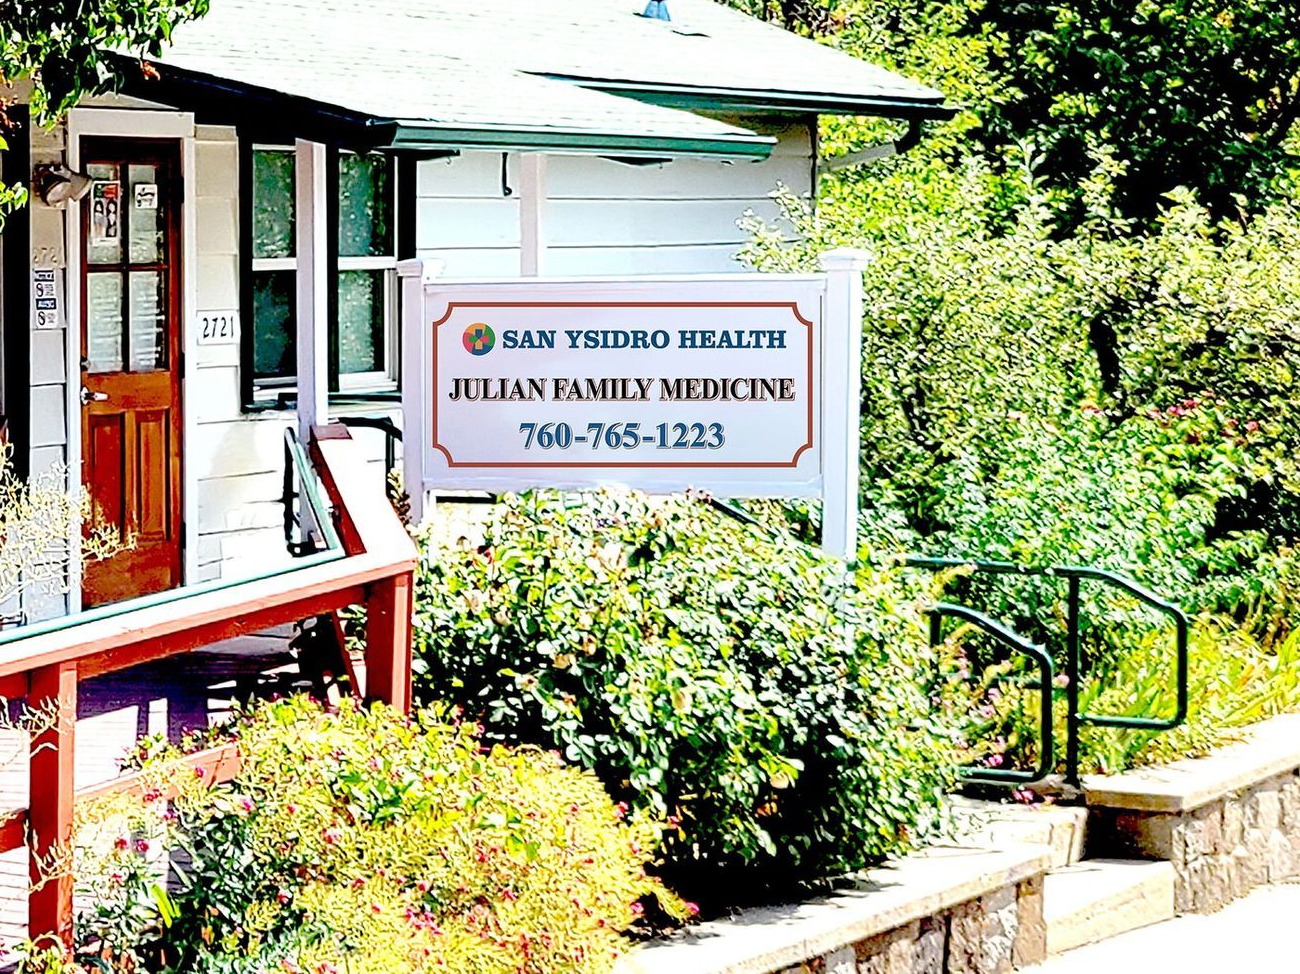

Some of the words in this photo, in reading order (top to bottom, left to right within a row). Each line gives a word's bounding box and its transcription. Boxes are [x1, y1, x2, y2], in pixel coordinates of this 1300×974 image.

[202, 315, 234, 339] 2721
[502, 329, 557, 349] SAN
[564, 329, 670, 349] YSIDRO
[677, 329, 787, 349] HEALTH
[448, 377, 547, 401] JULIAN
[551, 377, 654, 401] FAMILY
[659, 377, 796, 401] MEDICINE
[518, 421, 726, 450] 760-765-1223
